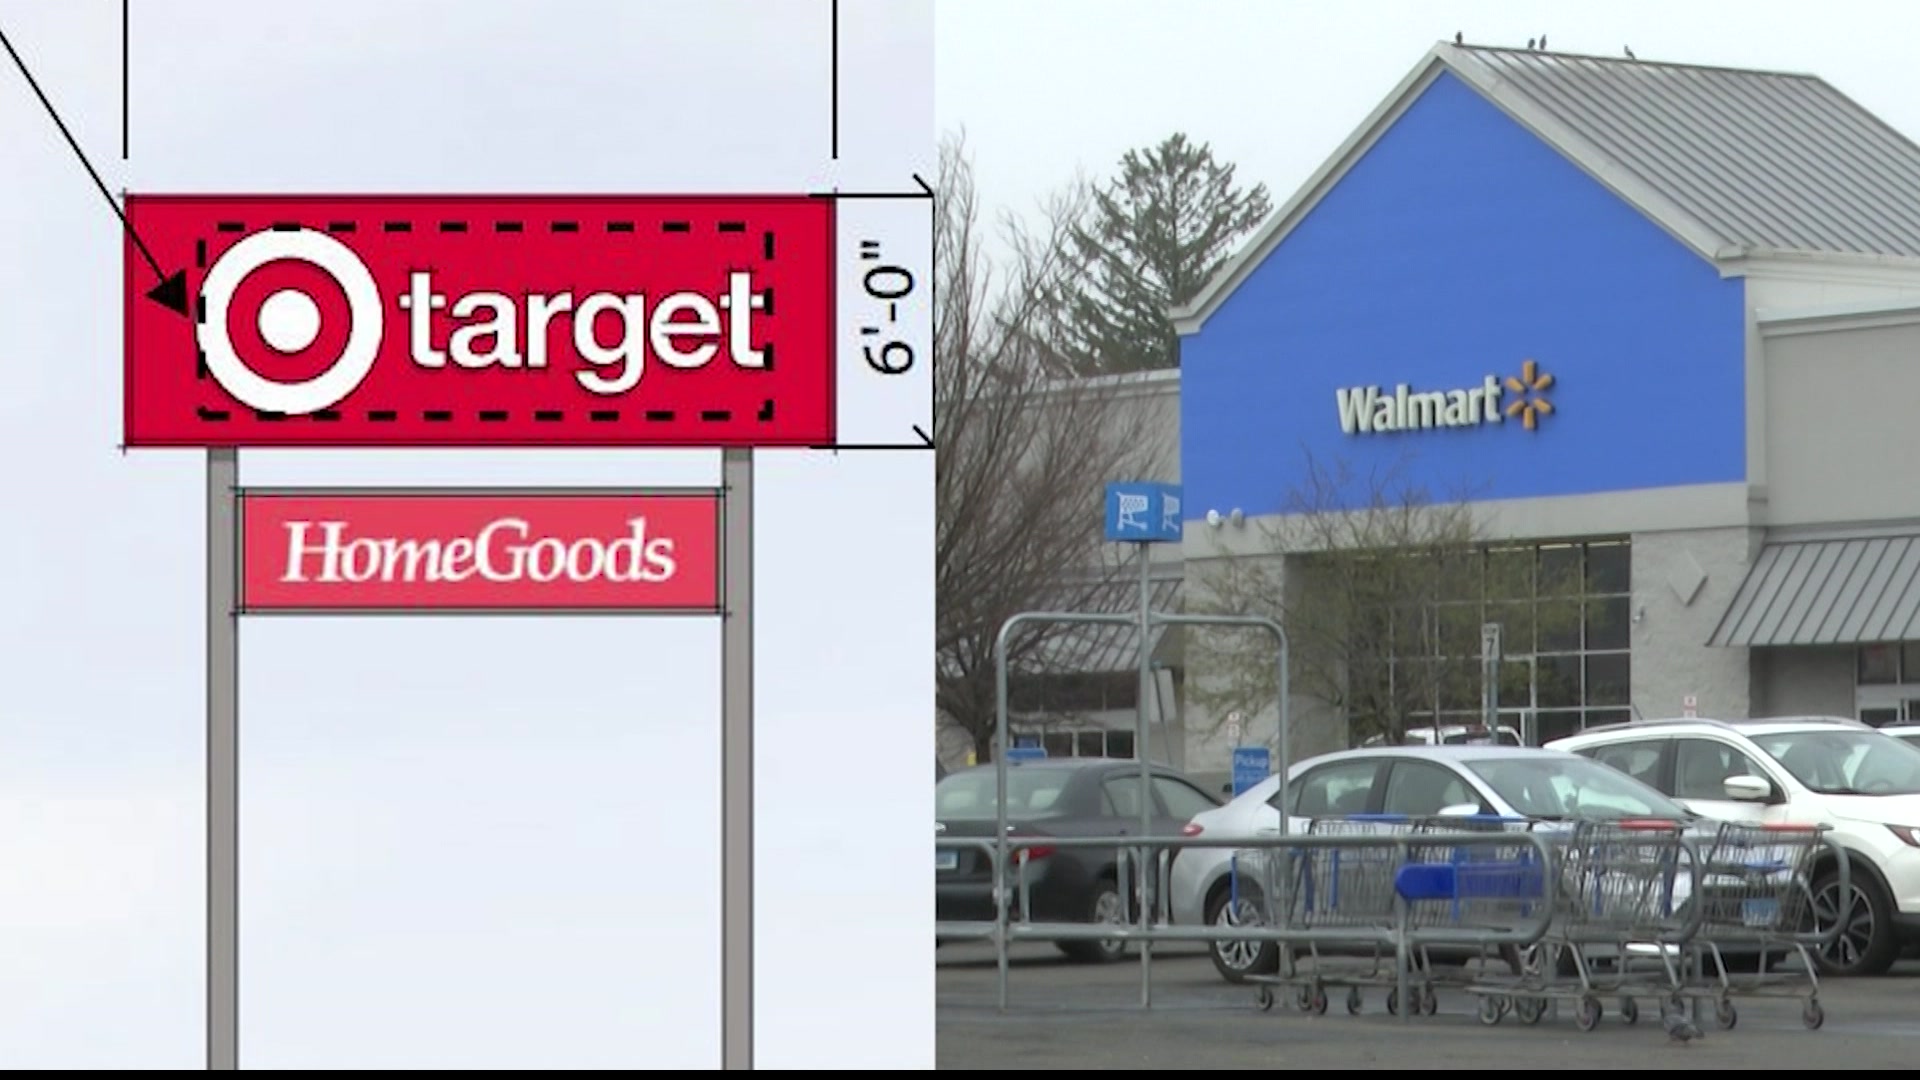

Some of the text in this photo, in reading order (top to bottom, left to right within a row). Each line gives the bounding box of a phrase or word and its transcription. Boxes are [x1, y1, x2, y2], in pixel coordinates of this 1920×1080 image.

[399, 271, 766, 395] target
[1336, 375, 1502, 434] Walmart
[280, 516, 676, 582] HomeGoods
